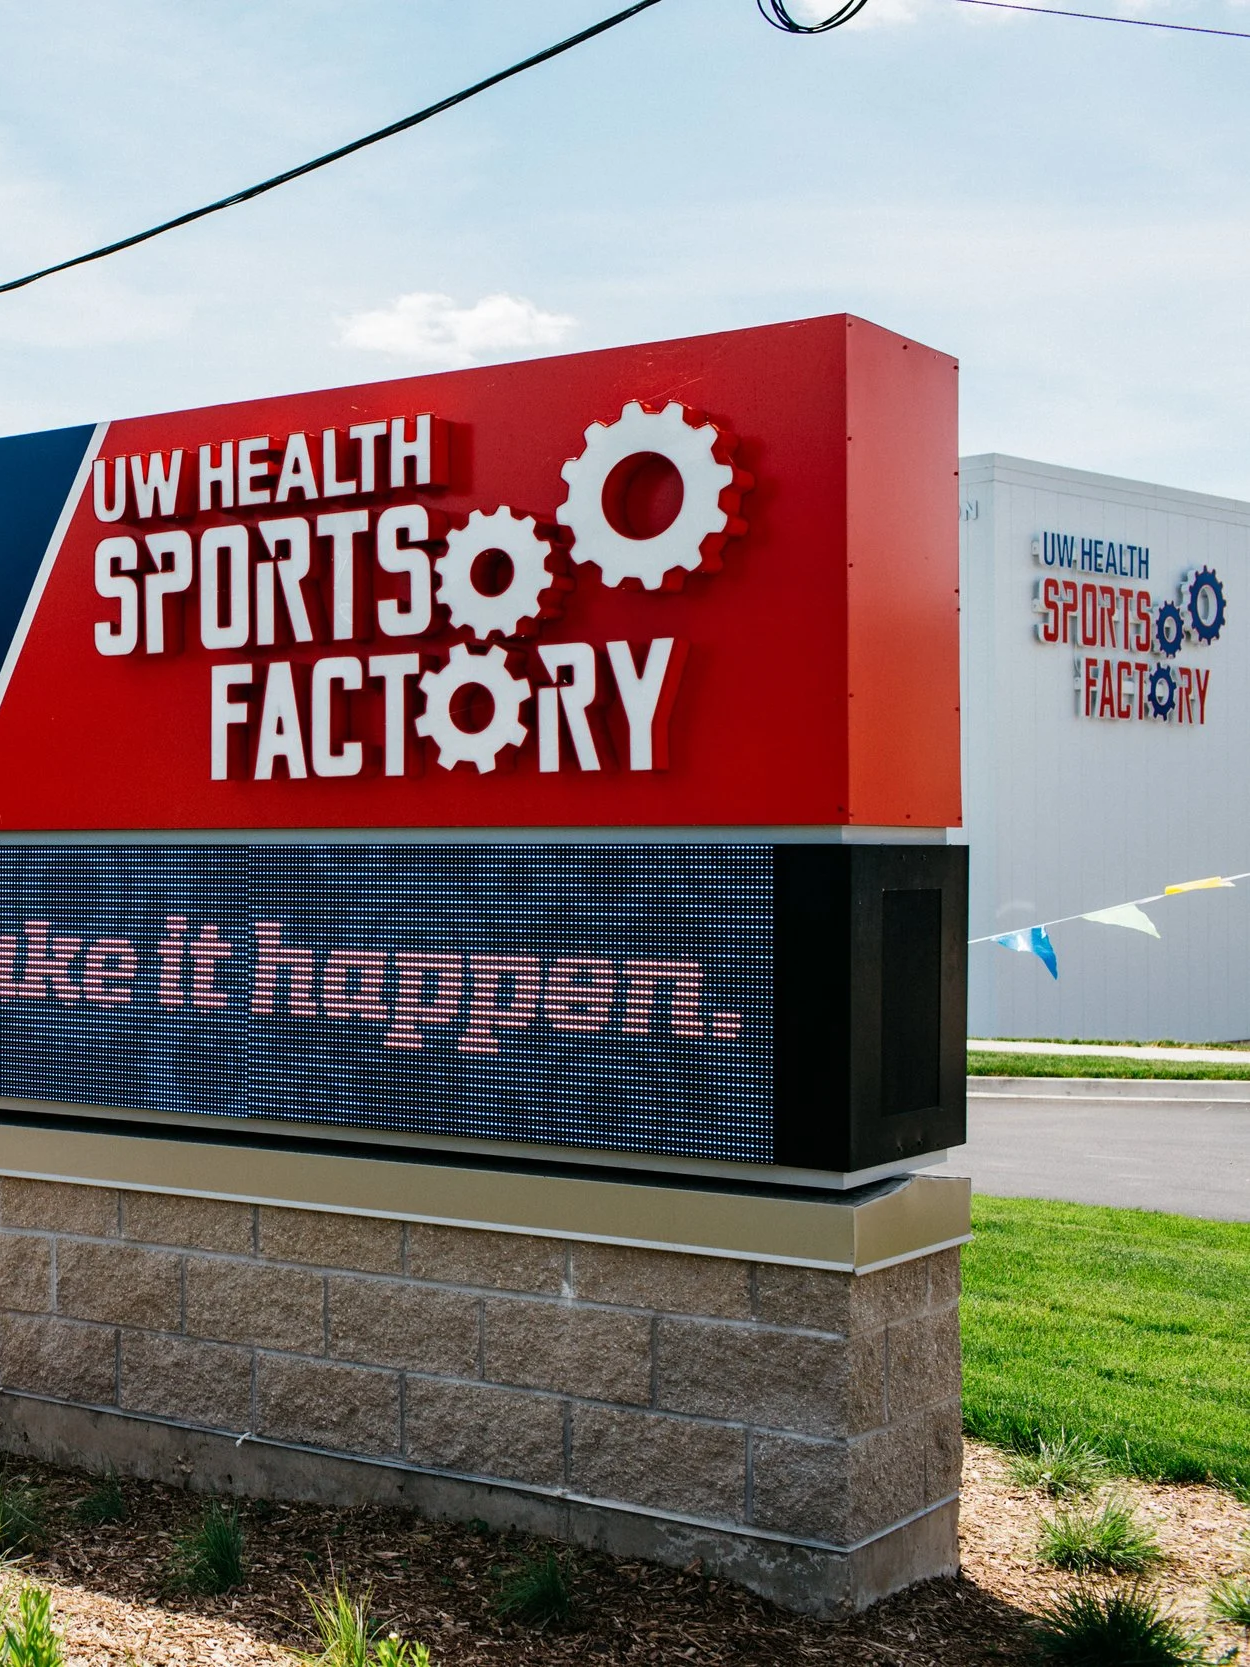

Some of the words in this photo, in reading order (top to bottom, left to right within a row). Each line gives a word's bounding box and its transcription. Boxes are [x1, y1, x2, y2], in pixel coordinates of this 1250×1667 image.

[92, 448, 184, 523] UW
[198, 412, 432, 511] HEALTH
[93, 504, 432, 657] SPORTS
[1043, 531, 1075, 568] UW
[1081, 537, 1149, 580] HEALTH
[1043, 577, 1152, 653] SPORTS
[210, 637, 675, 781] FACTORY
[1085, 657, 1210, 725] FACTORY
[158, 916, 233, 1008] it
[251, 921, 742, 1055] happen.
